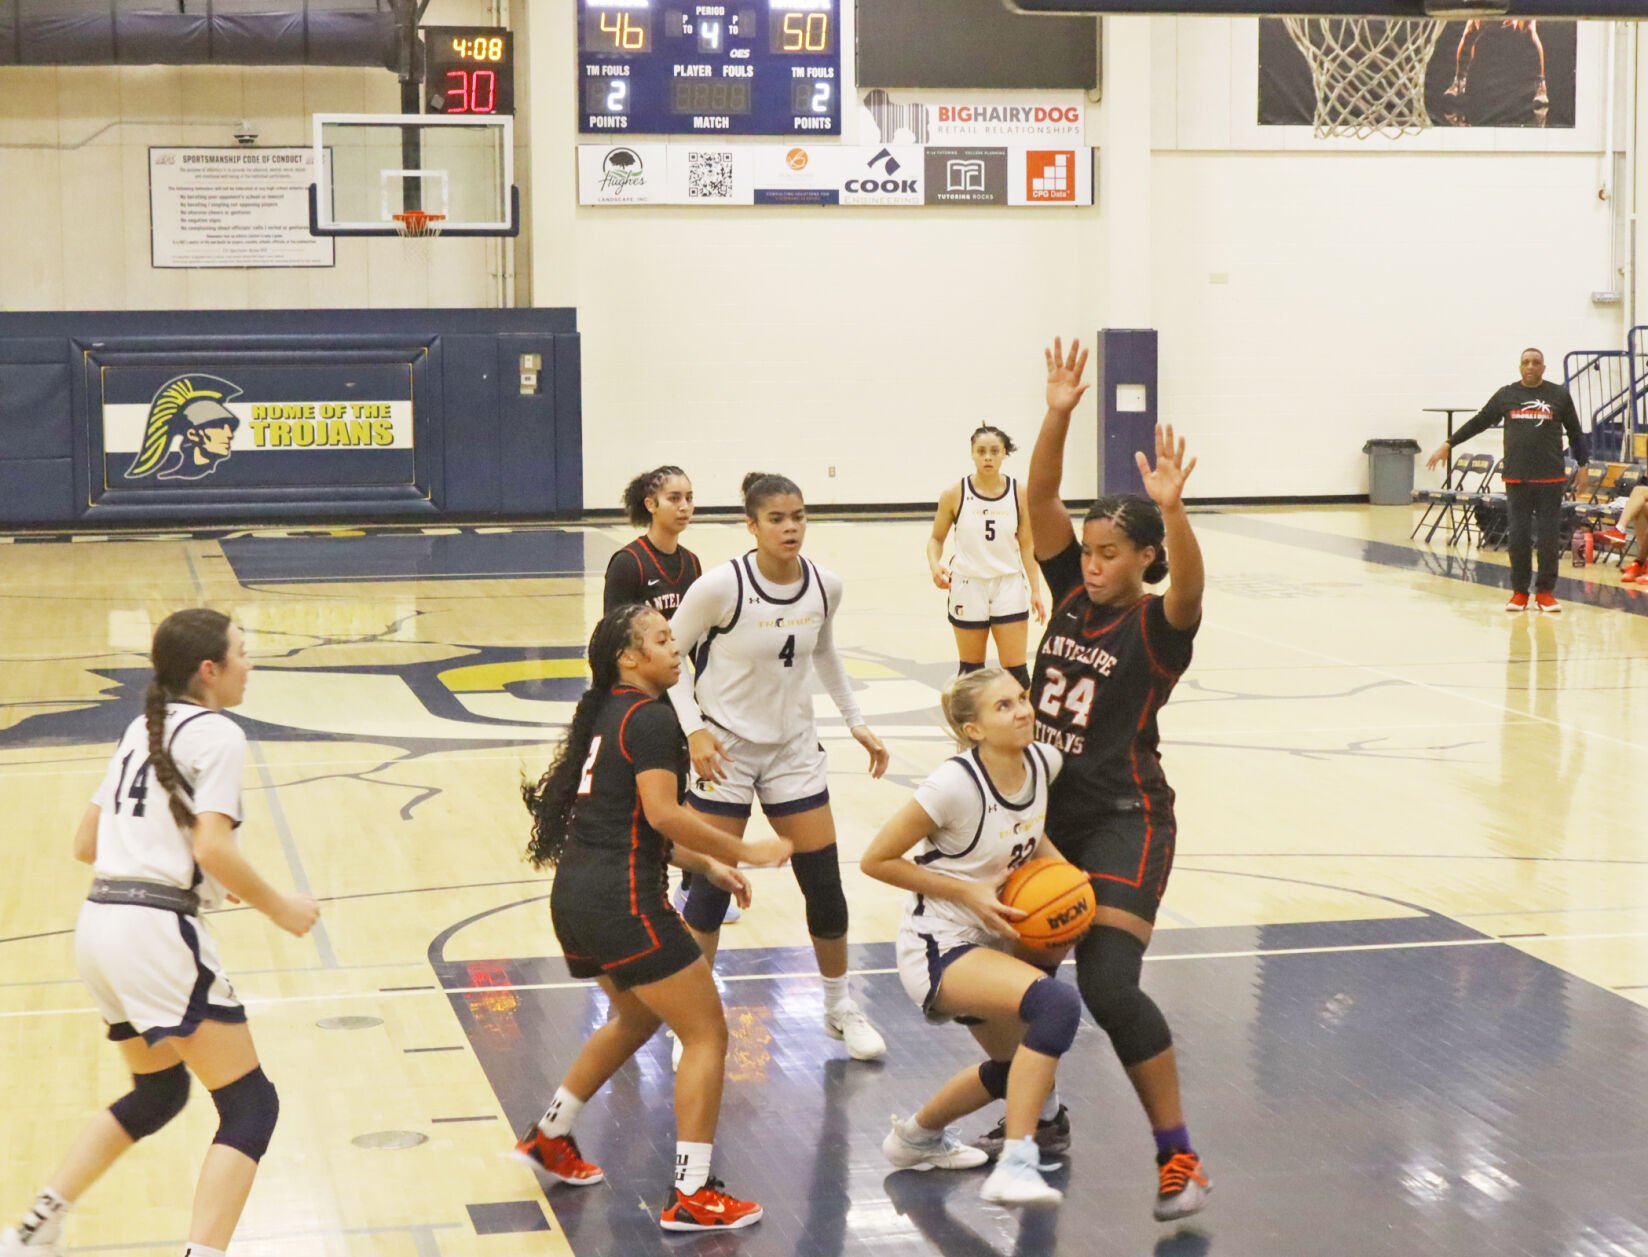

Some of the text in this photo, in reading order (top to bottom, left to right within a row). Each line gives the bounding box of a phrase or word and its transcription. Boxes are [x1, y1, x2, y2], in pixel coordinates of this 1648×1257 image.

[696, 6, 725, 16] PERIOD
[682, 15, 688, 24] P
[732, 15, 739, 24] P
[600, 12, 643, 49] 46
[683, 25, 693, 34] TO
[702, 22, 719, 49] 4
[729, 25, 738, 34] TO
[784, 13, 827, 51] 50
[453, 37, 503, 61] 4:08
[729, 49, 750, 58] OES
[586, 65, 630, 76] TM FOULS
[673, 65, 754, 77] PLAYER FOULS
[791, 67, 834, 78] TM FOULS
[447, 70, 495, 113] 30
[607, 80, 626, 111] 2
[812, 82, 830, 112] 2
[938, 106, 1080, 123] BIGHAIRYDOG
[589, 116, 628, 128] POINTS
[693, 117, 730, 129] MATCH
[794, 117, 832, 129] POINTS
[938, 126, 1081, 134] RETAIL RELATIONSHIPS
[183, 155, 241, 163] SPORTSMANSHIP
[243, 155, 259, 164] CODE
[261, 155, 270, 164] OF
[272, 155, 302, 163] CONDUCT
[598, 170, 647, 196] Hughes
[845, 180, 918, 193] COOK
[1033, 190, 1049, 198] CPG
[251, 403, 392, 421] HOME OF THE
[250, 420, 395, 447] TROJANS
[985, 520, 996, 541] 5
[778, 634, 796, 668] 4
[1038, 666, 1097, 728] 24
[115, 749, 153, 818] 14
